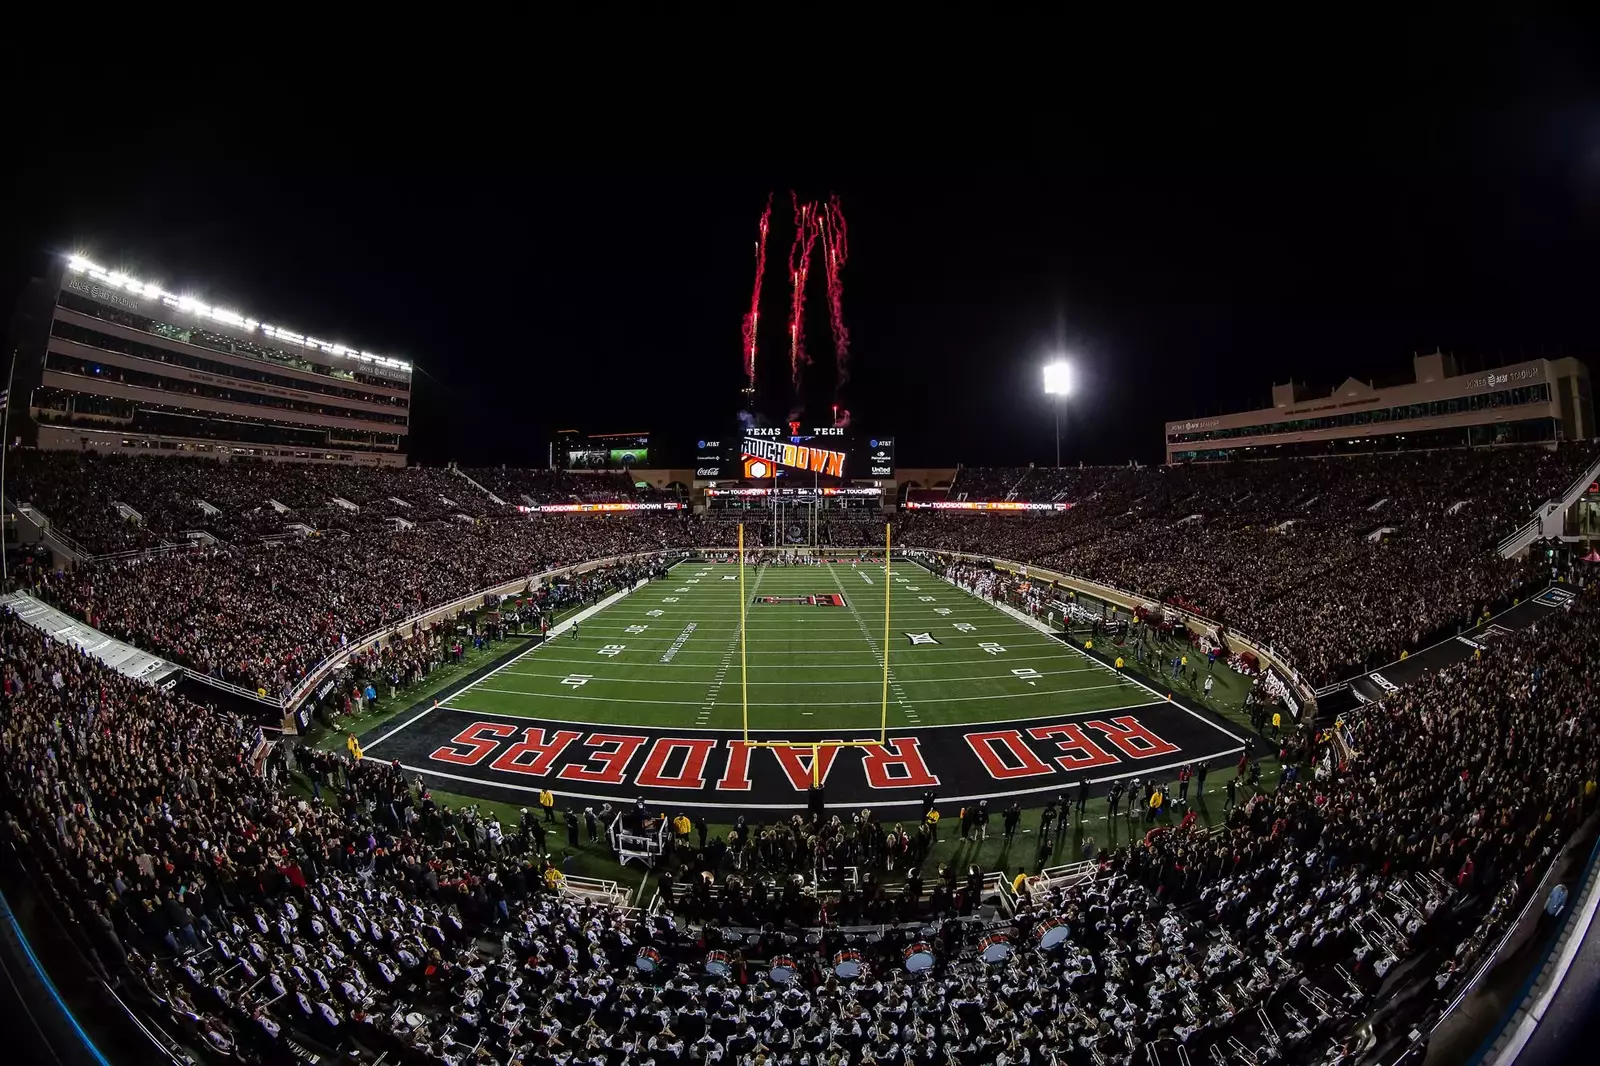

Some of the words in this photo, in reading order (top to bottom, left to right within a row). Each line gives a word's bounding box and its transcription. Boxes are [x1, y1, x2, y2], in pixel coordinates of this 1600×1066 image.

[746, 428, 781, 436] TEXAS
[813, 428, 844, 436] TECH
[541, 505, 578, 513] TOUCHDOWN
[1369, 672, 1400, 692] GEICO
[428, 721, 942, 792] RAIDERS
[962, 714, 1184, 780] RED
